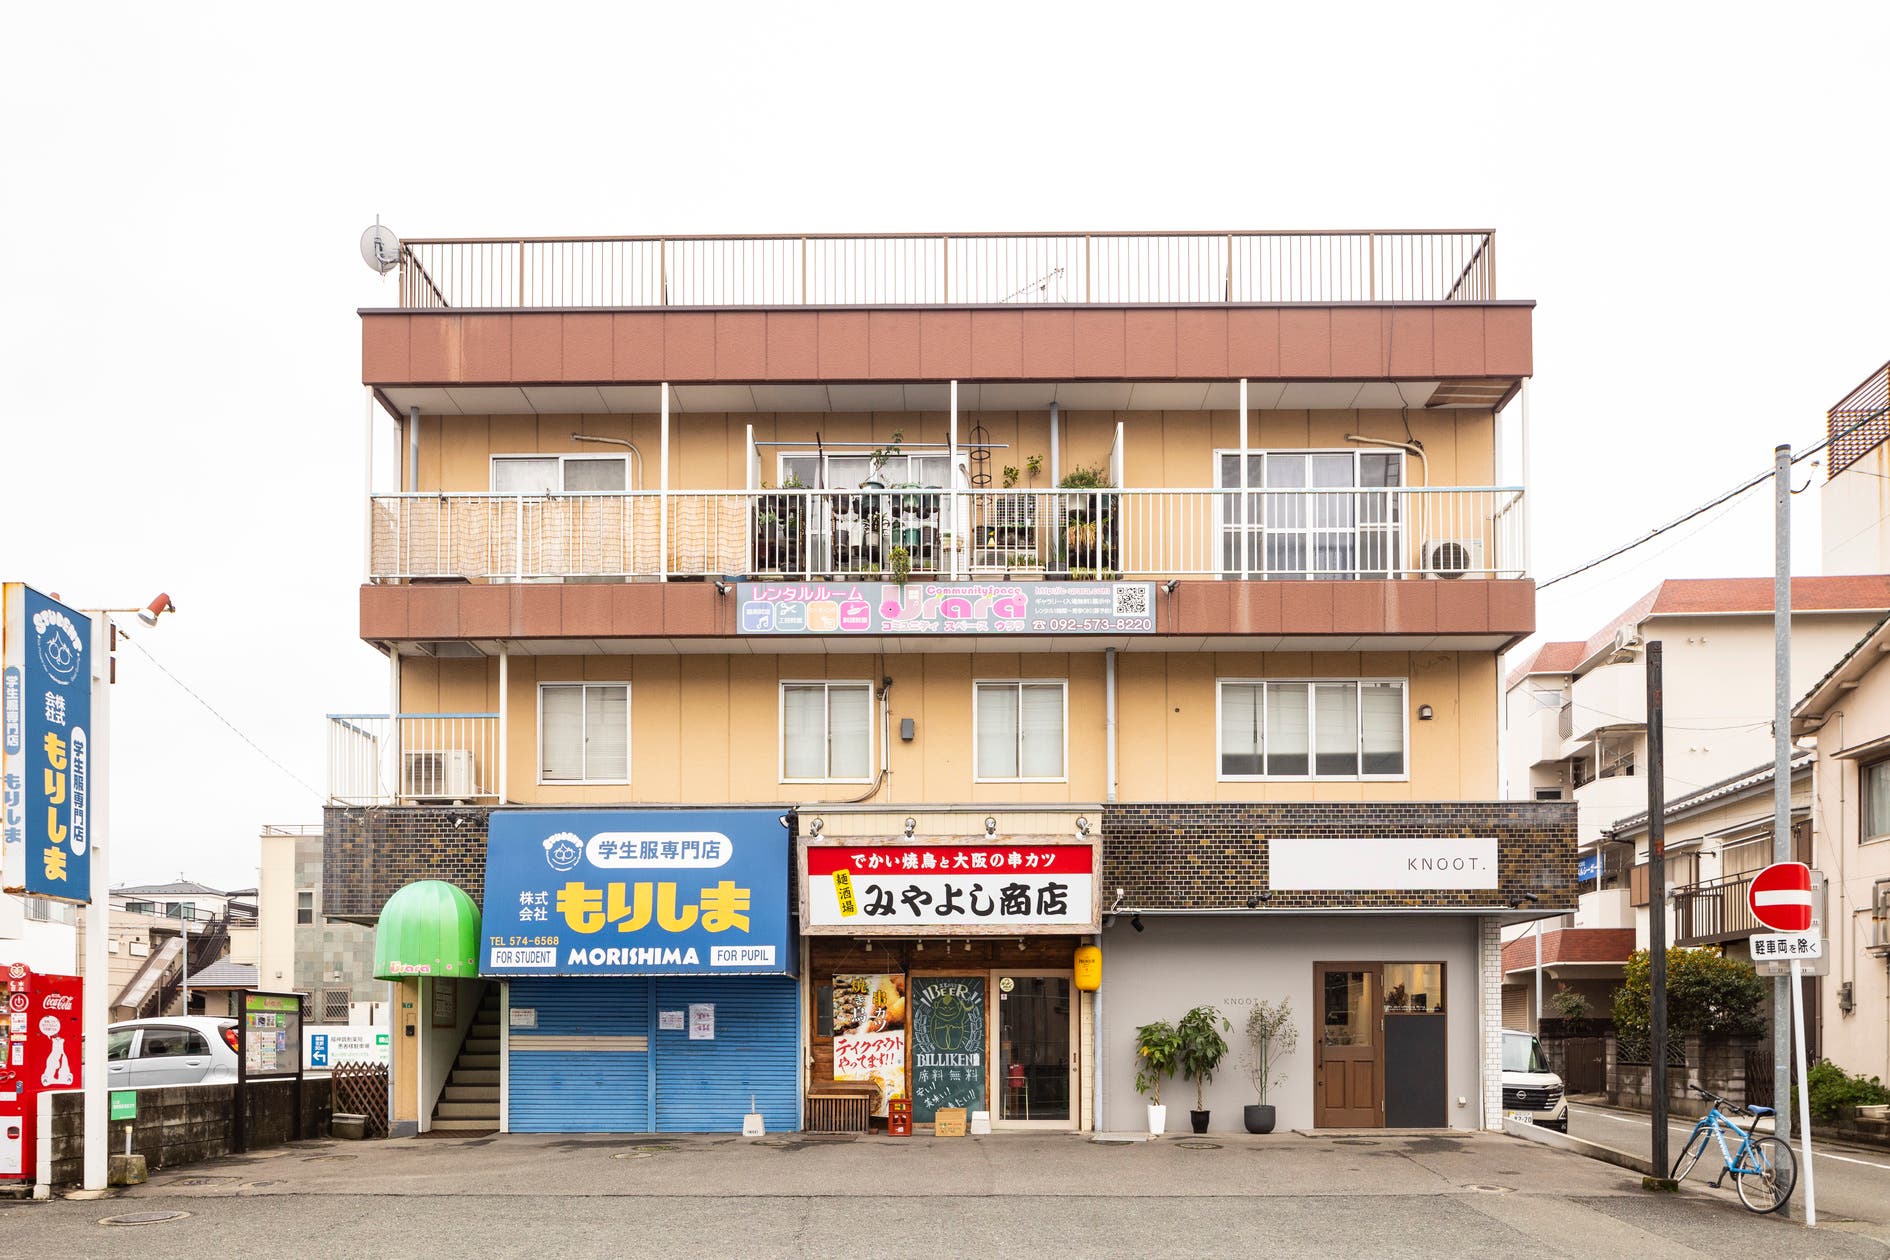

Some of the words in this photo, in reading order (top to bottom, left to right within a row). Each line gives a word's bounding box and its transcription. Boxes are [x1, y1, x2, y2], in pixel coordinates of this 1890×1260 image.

[752, 586, 864, 602] レンタルルーム
[879, 584, 1028, 620] Urara
[881, 621, 939, 631] コミュニティ
[944, 621, 989, 631] スペース
[994, 621, 1025, 631] ウララ
[1049, 618, 1152, 631] 092-573-8220
[4, 772, 22, 844] もりしま
[43, 731, 68, 882] もりしま
[598, 840, 721, 860] 学生服専門店
[850, 851, 1057, 870] でかい焼鳥と大阪の串カツ
[1407, 857, 1487, 871] KNOOT.
[519, 890, 549, 906] 株式
[836, 873, 855, 913] 麺酒場
[863, 881, 1069, 917] みやよし商店
[519, 906, 548, 922] 会社
[556, 880, 751, 934] もりしま
[490, 936, 506, 946] TEL
[509, 936, 559, 946] 574-6568
[1755, 938, 1817, 955] 軽車両を除く
[496, 951, 513, 964] FOR
[515, 951, 551, 964] STUDENT
[567, 947, 700, 966] MORISHIMA
[717, 950, 738, 961] FOR
[741, 949, 769, 961] PUPIL
[43, 993, 74, 1010] Coca-Cola
[851, 977, 868, 1023] 焼き鳥
[927, 984, 969, 1001] BEER
[872, 989, 888, 1033] 串カツ
[836, 1036, 904, 1056] テイクアウト
